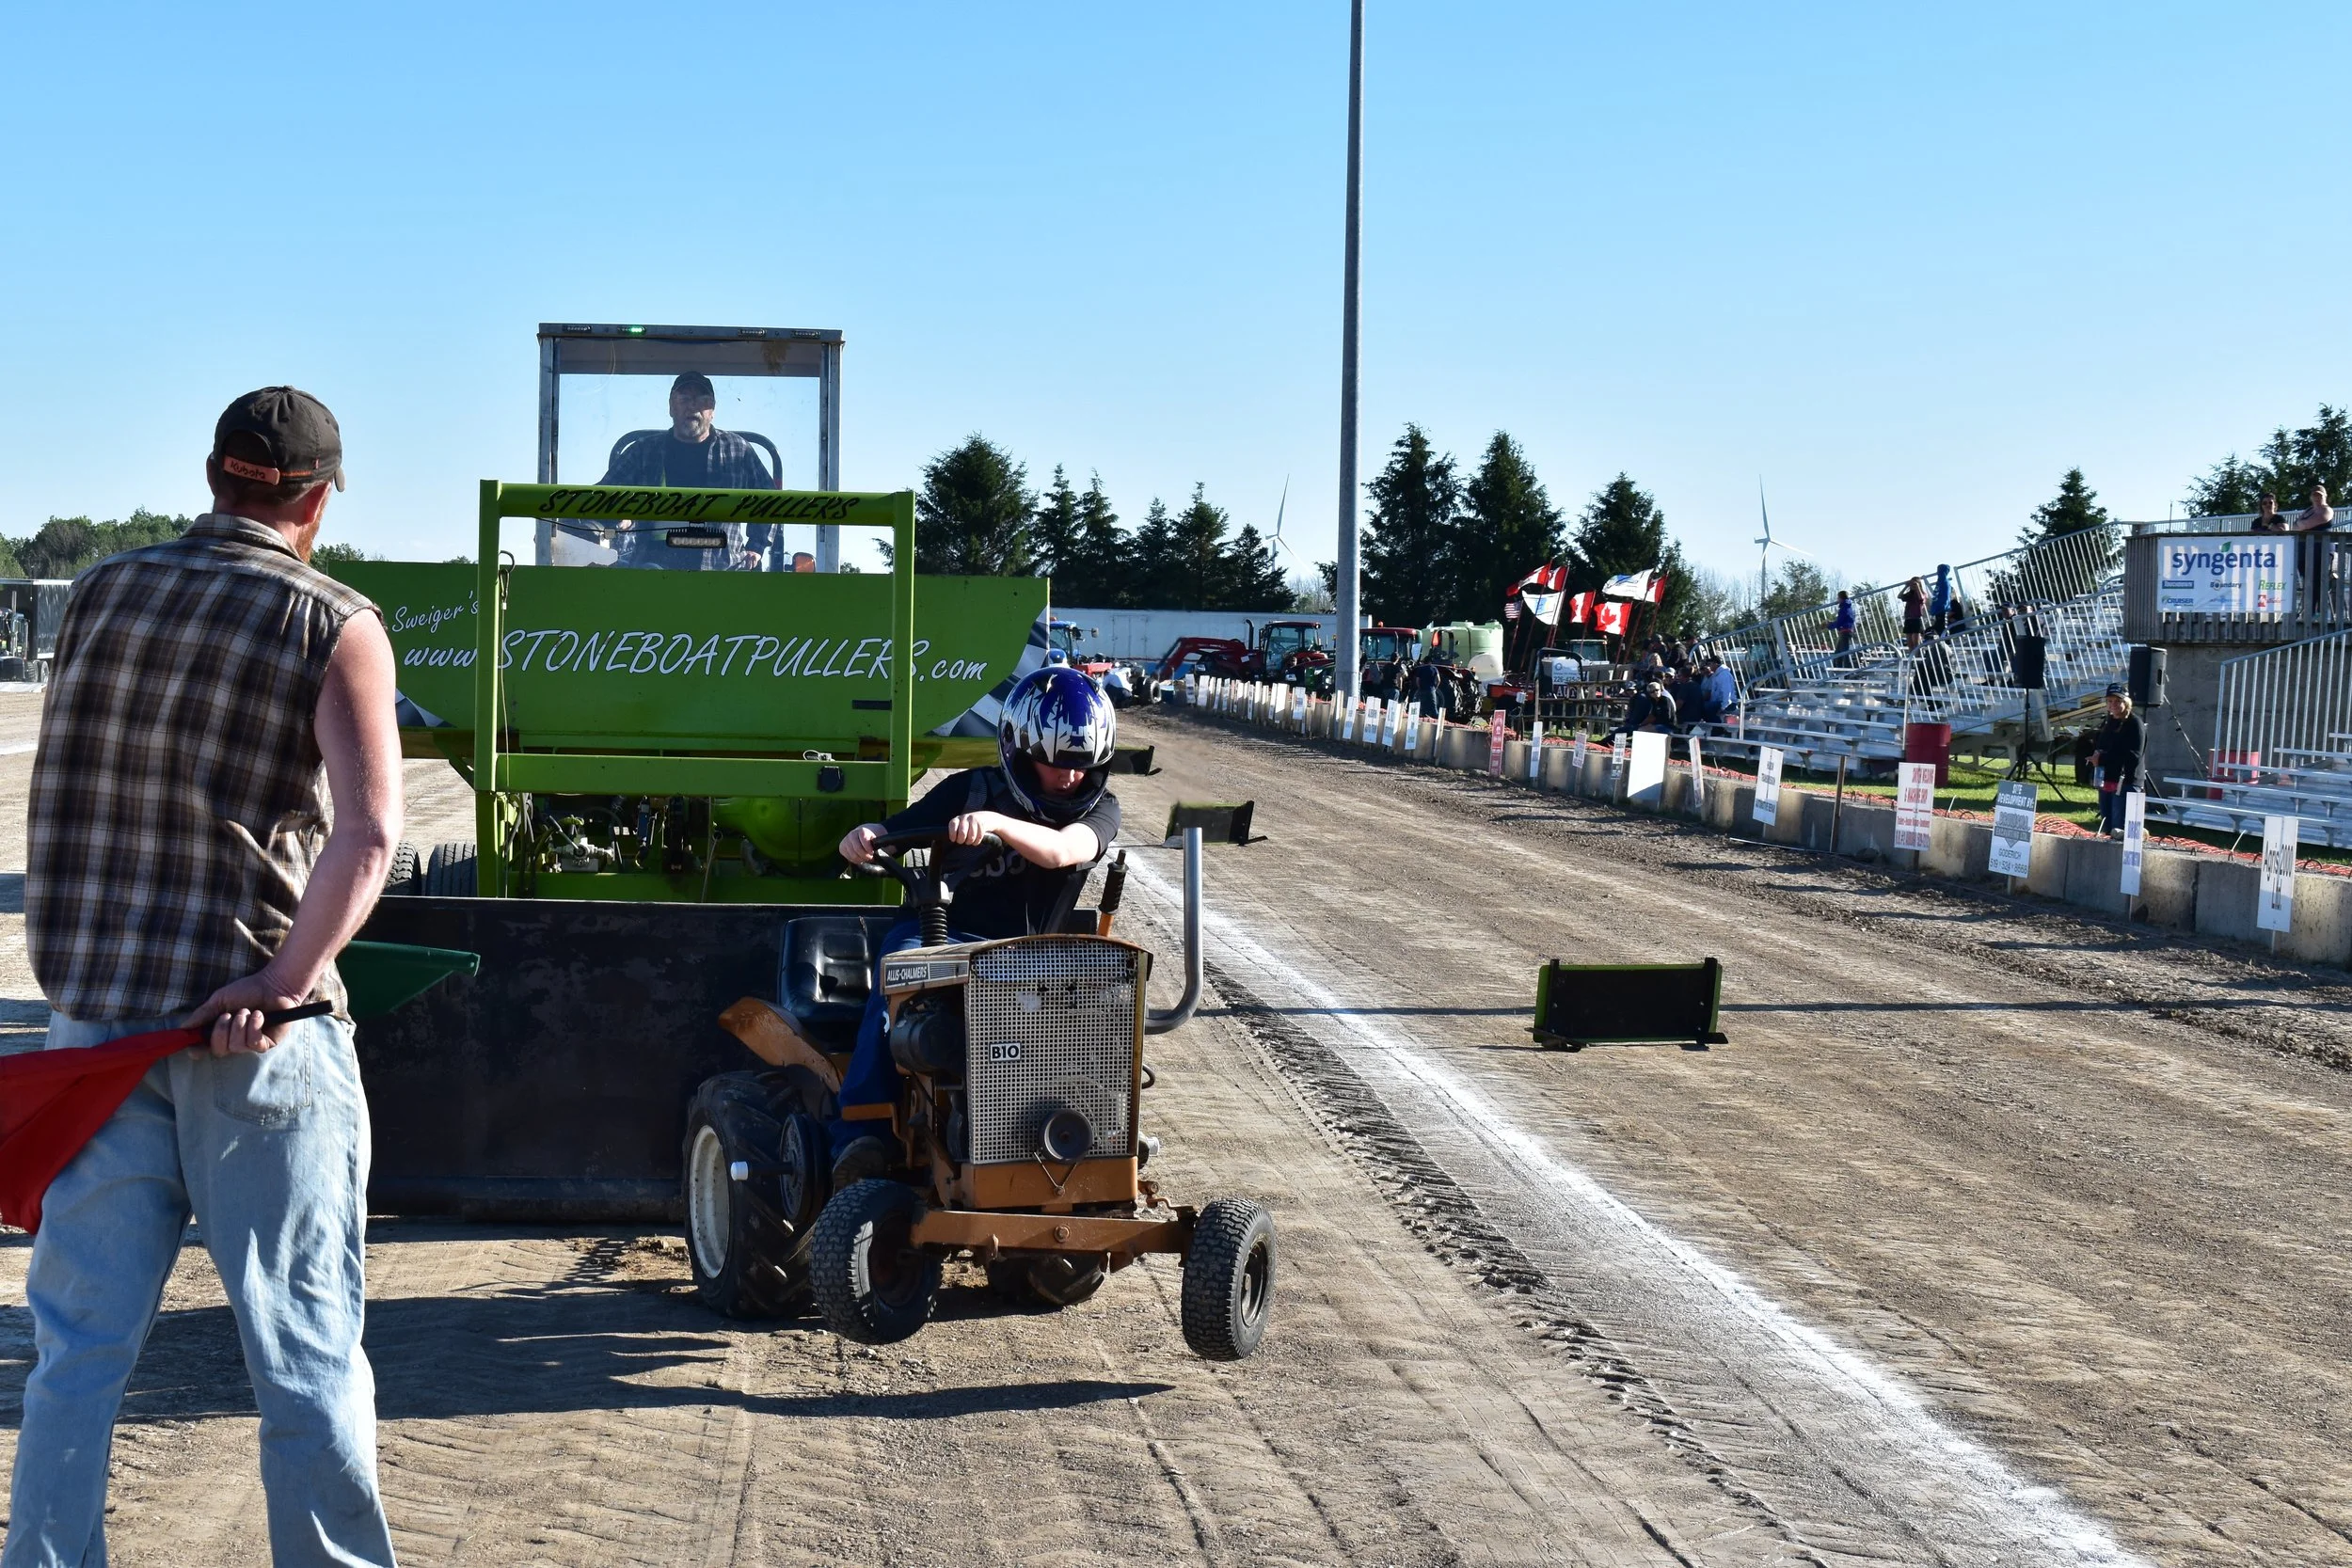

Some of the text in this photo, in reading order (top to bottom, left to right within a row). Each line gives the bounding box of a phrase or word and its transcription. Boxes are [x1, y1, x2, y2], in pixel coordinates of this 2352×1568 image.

[230, 461, 265, 480] Kubota
[538, 488, 861, 520] STONEBOAT PULLERS
[2171, 548, 2276, 576] syngenta
[391, 590, 478, 633] Sweiger's
[1997, 793, 2027, 807] DEVELOPMENT
[1998, 847, 2022, 860] GODERICH
[887, 966, 928, 982] ALLIS-CHALMERS
[991, 1044, 1020, 1059] B10
